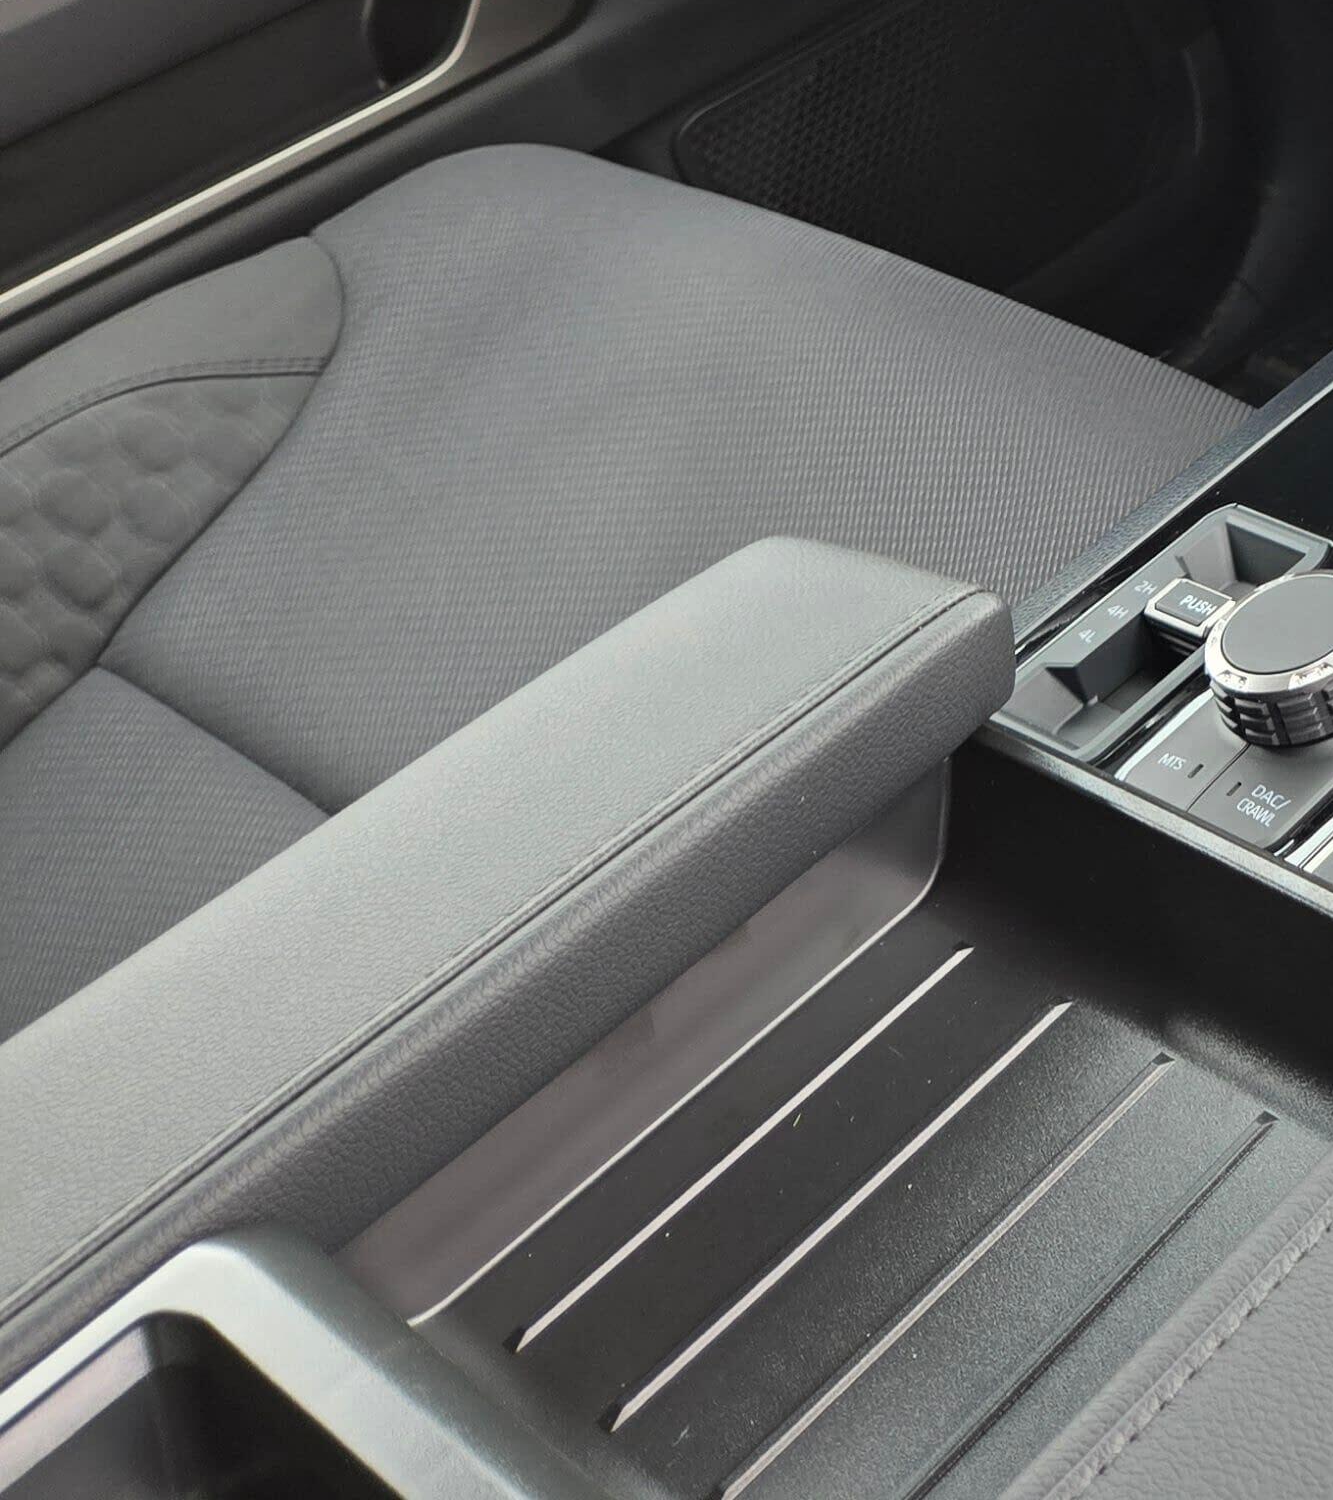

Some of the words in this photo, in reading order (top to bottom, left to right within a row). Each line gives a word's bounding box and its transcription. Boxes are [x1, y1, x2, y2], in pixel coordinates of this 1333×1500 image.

[1134, 580, 1157, 597] 2H
[1179, 593, 1219, 616] PUSH
[1106, 603, 1129, 620] 4H
[1077, 627, 1098, 644] 4L
[1157, 752, 1187, 771] MTS
[1250, 783, 1292, 811] DAC/
[1235, 797, 1278, 828] CRAWL
